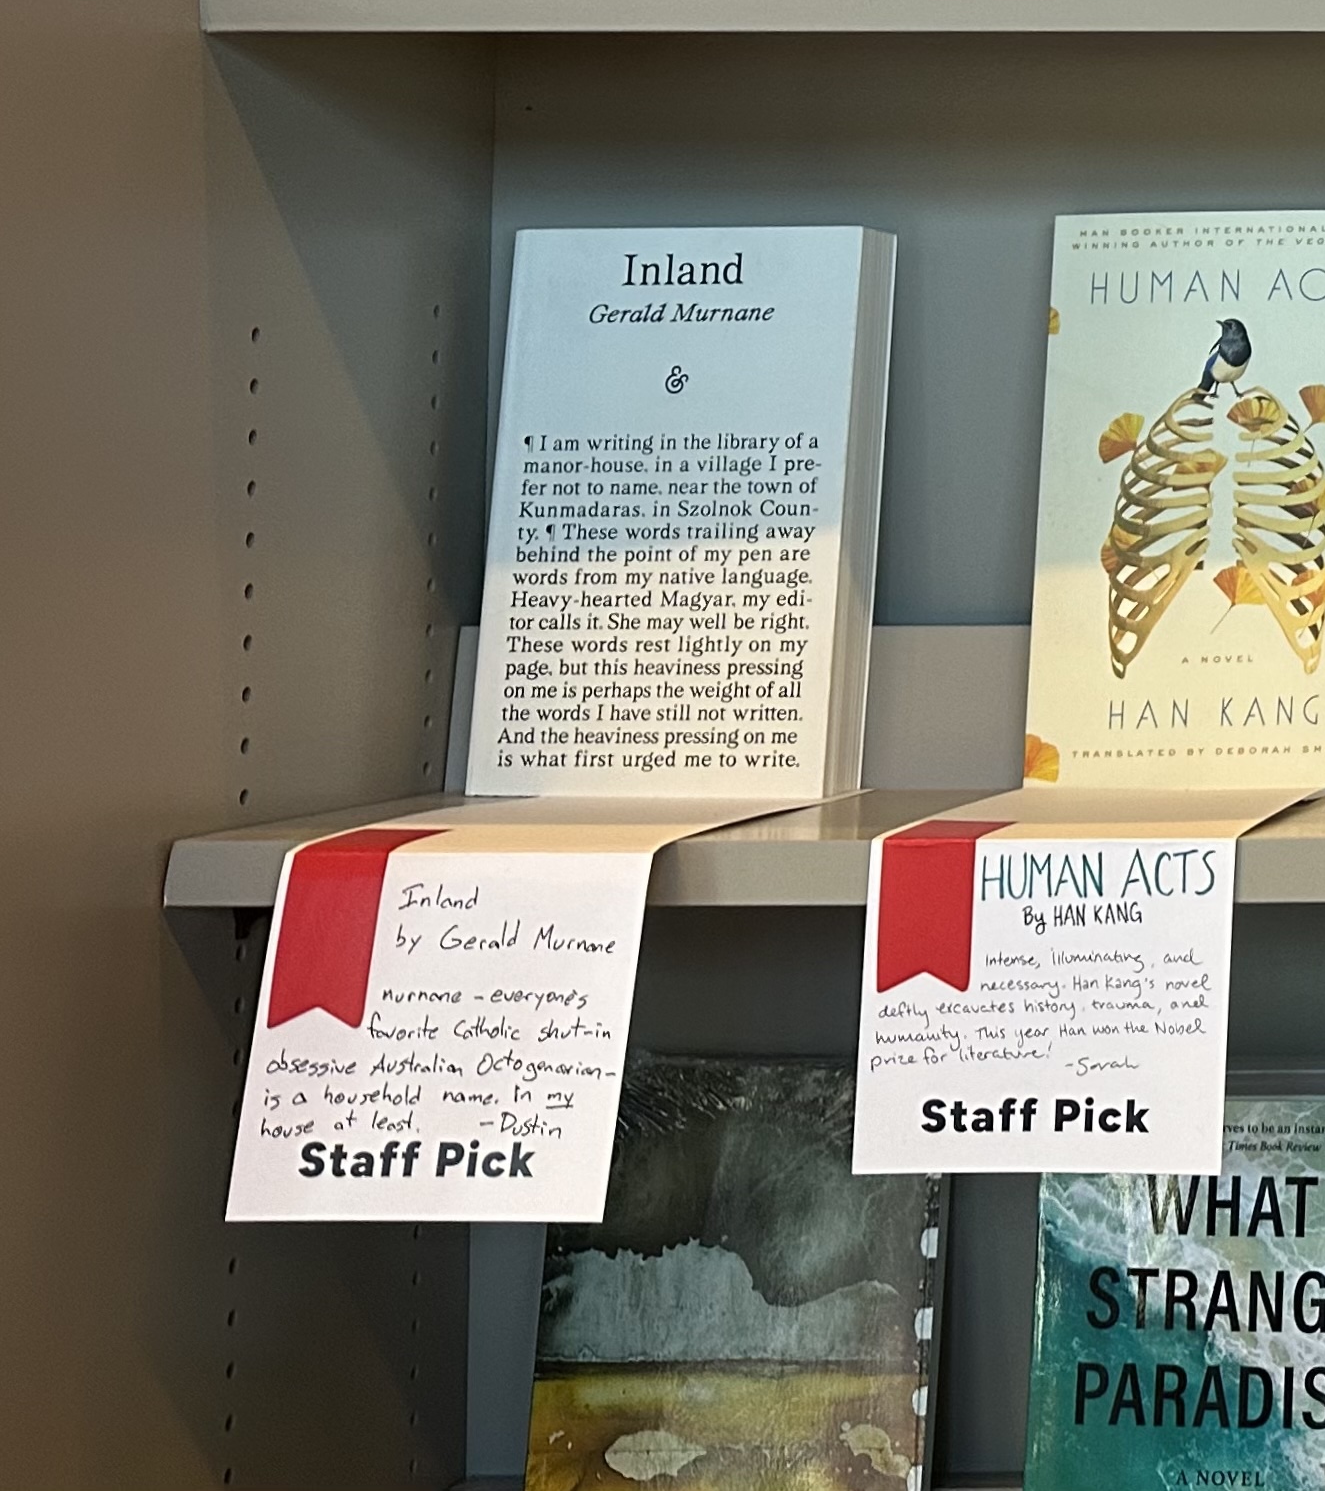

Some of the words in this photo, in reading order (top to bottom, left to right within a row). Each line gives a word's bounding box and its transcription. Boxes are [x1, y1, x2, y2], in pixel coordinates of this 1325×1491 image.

[622, 253, 744, 286] Inland
[1091, 269, 1239, 304] HUMAN
[589, 304, 665, 324] Gerald
[671, 304, 775, 322] Murnane
[539, 435, 547, 451] I
[553, 437, 580, 451] am
[587, 434, 654, 455] writing
[660, 434, 677, 450] in
[683, 434, 711, 450] the
[717, 433, 779, 454] library
[785, 433, 803, 449] of
[808, 436, 818, 449] a
[1108, 699, 1190, 730] HAN
[1220, 694, 1320, 727] KANG
[981, 851, 1103, 901] HUMAN
[1121, 848, 1216, 898] ACTS
[399, 883, 479, 911] Inland
[1022, 906, 1046, 935] By
[1053, 905, 1086, 928] HAN
[1094, 901, 1143, 925] KANG
[395, 927, 422, 955] by
[440, 920, 519, 951] Gerald
[533, 923, 617, 955] Murnane
[921, 1098, 1039, 1133] Staff
[1054, 1097, 1150, 1133] Pick
[298, 1141, 421, 1179] Staff
[436, 1140, 536, 1178] Pick
[1147, 1174, 1319, 1238] WHAT
[1176, 1470, 1188, 1485] A
[1196, 1470, 1265, 1488] NOVEL
